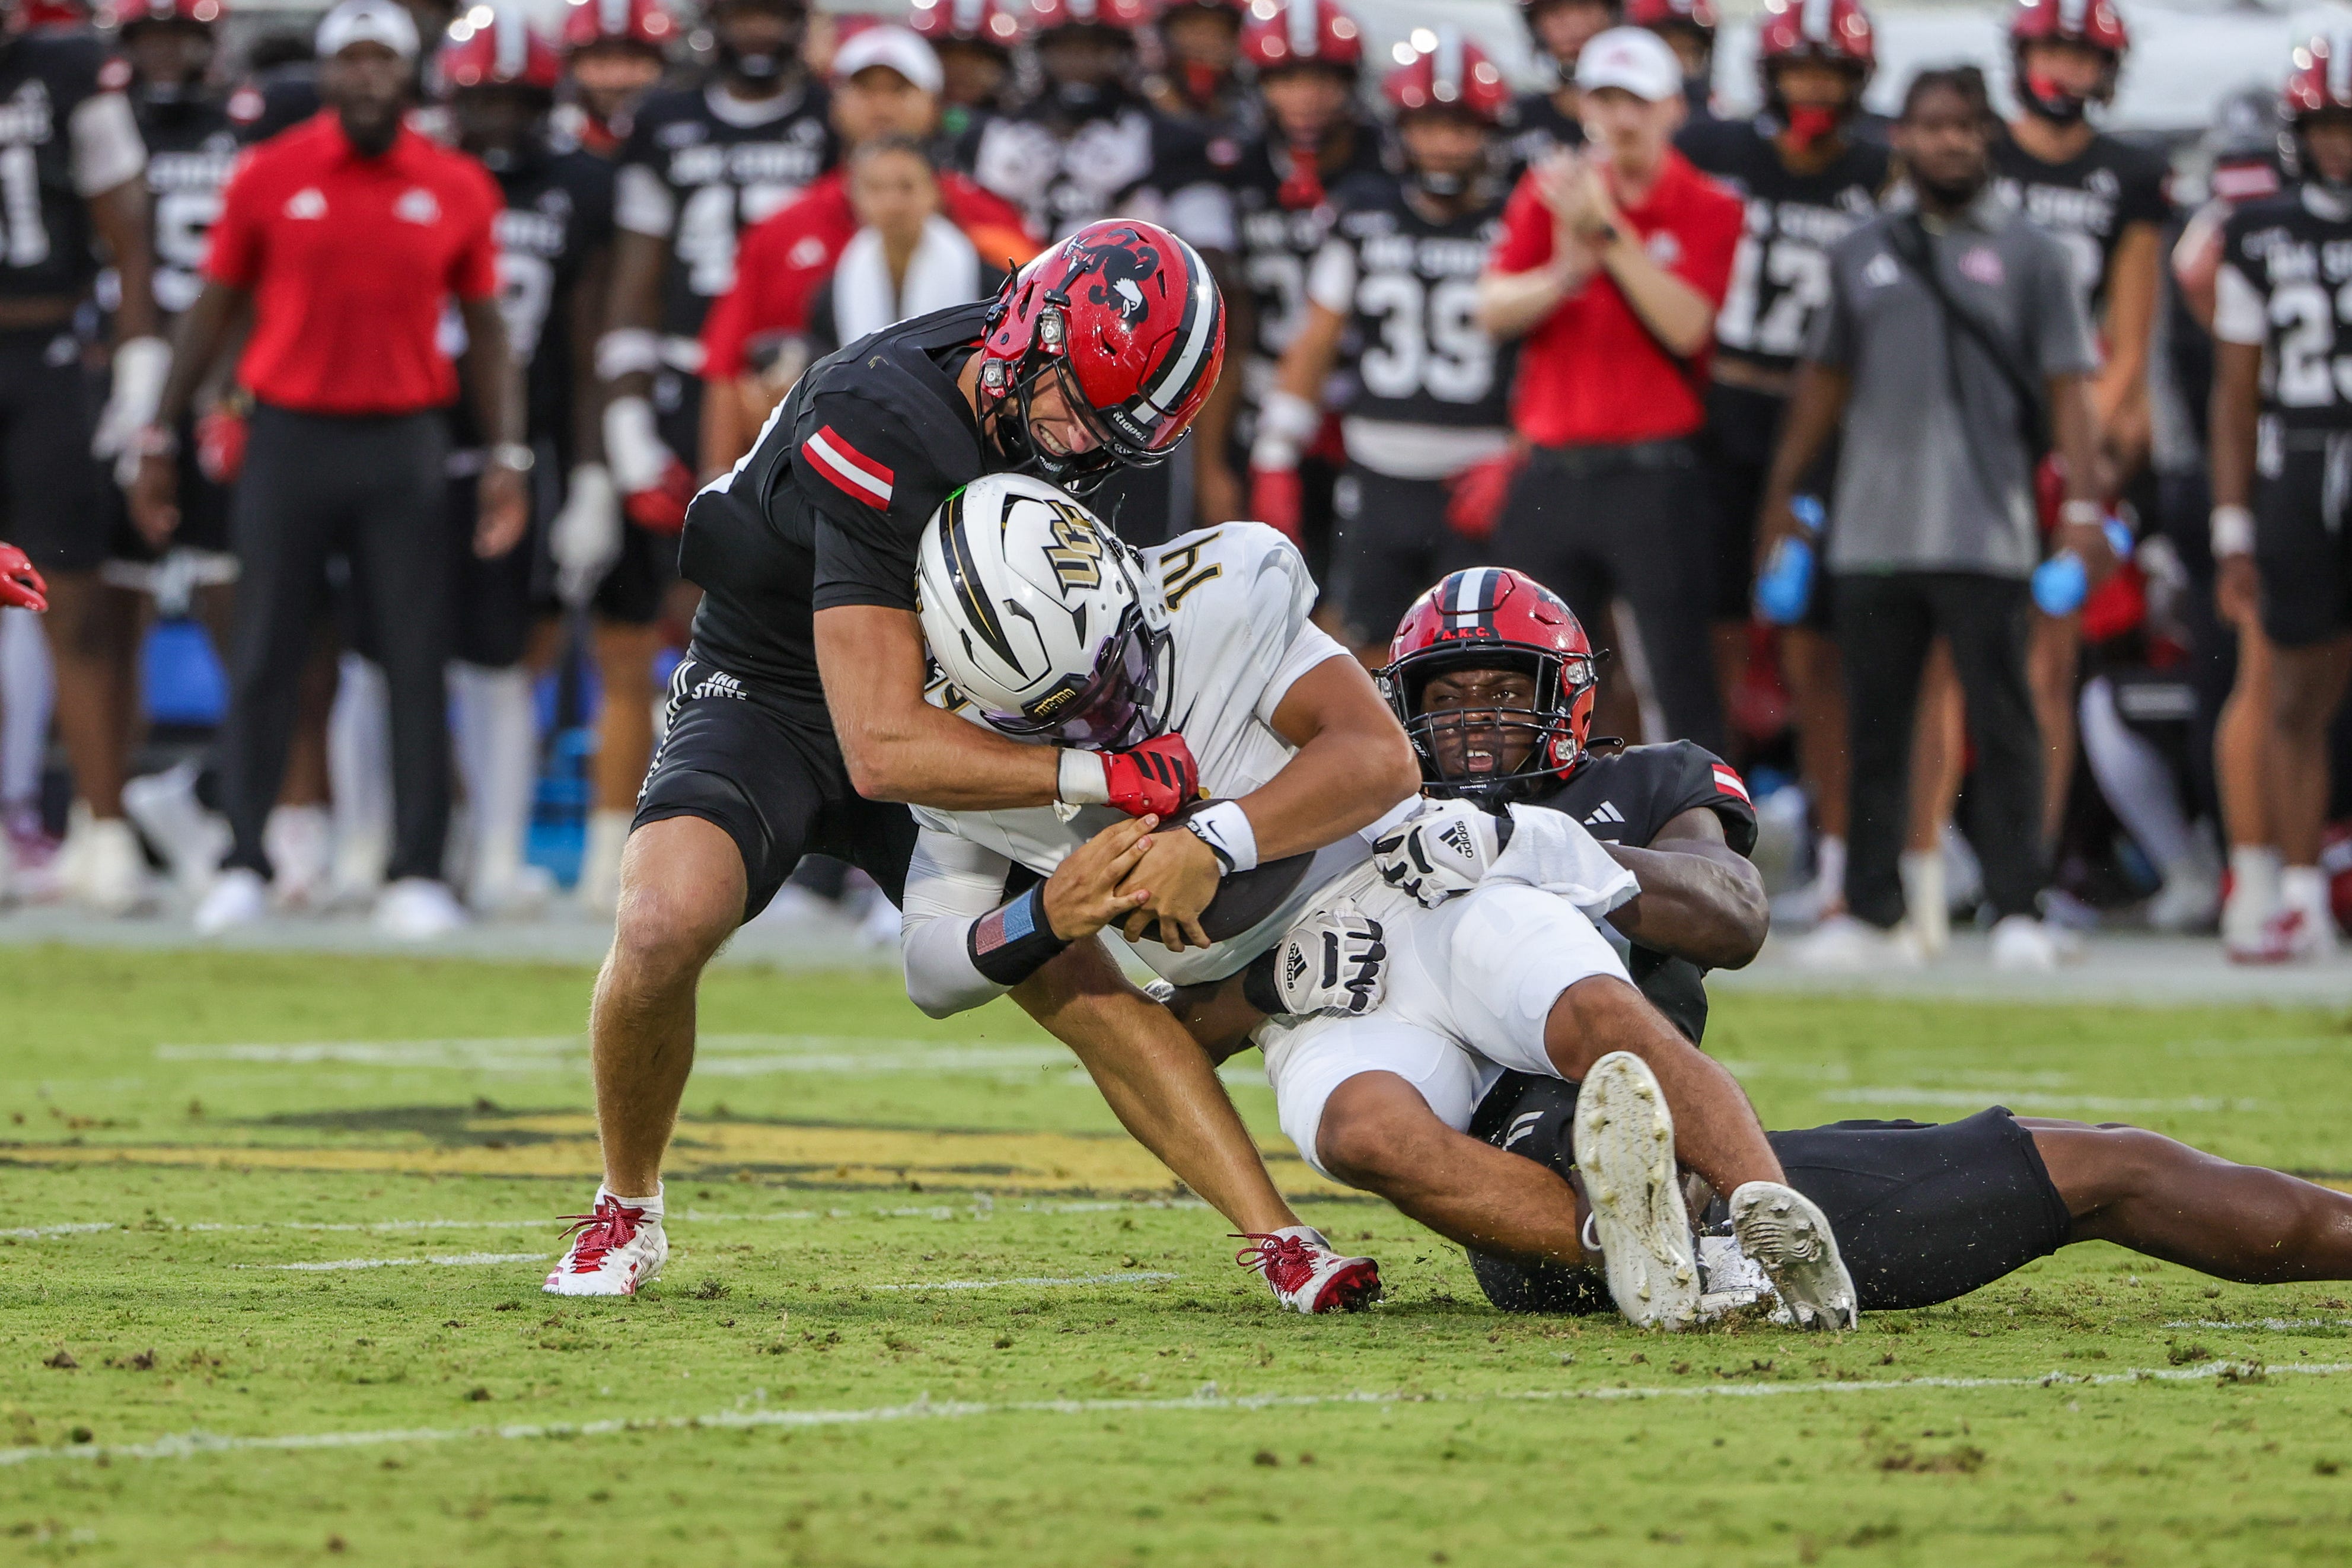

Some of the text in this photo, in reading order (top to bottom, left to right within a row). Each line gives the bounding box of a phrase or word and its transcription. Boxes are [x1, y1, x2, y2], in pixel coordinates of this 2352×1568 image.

[1042, 500, 1104, 600] UCF
[1159, 530, 1224, 612] 14
[1440, 627, 1491, 640] A. K. C.
[691, 682, 748, 700] STATE
[1455, 820, 1474, 859] adidas
[1286, 942, 1296, 990] adidas
